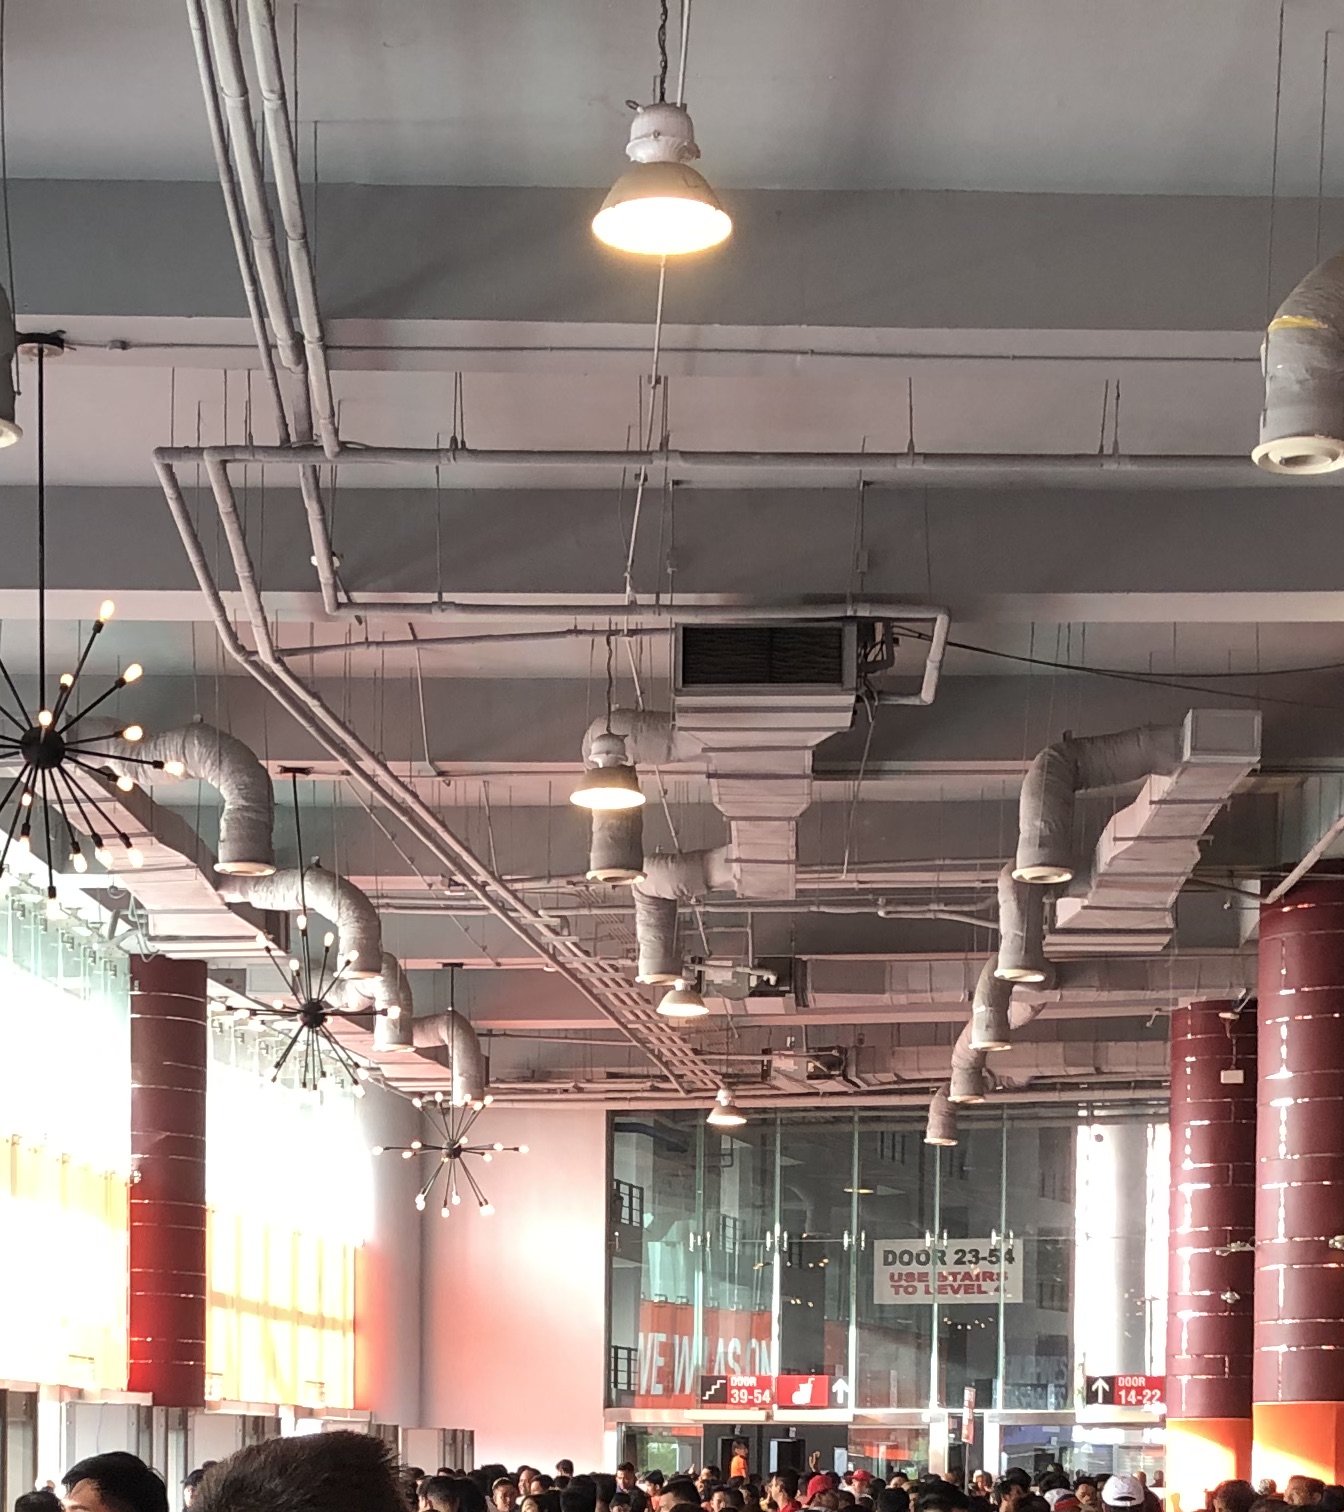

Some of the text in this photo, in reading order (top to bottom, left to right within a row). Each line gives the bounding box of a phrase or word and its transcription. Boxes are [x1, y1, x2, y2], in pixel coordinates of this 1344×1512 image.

[883, 1248, 1016, 1267] DOOR 23-54
[889, 1271, 1008, 1283] USE STAIRS
[890, 1284, 918, 1295] TO
[924, 1284, 988, 1295] LEVEL
[730, 1375, 757, 1387] DOOR
[1118, 1376, 1146, 1387] DOOR
[730, 1388, 771, 1404] 39-54
[1118, 1388, 1162, 1405] 14-22
